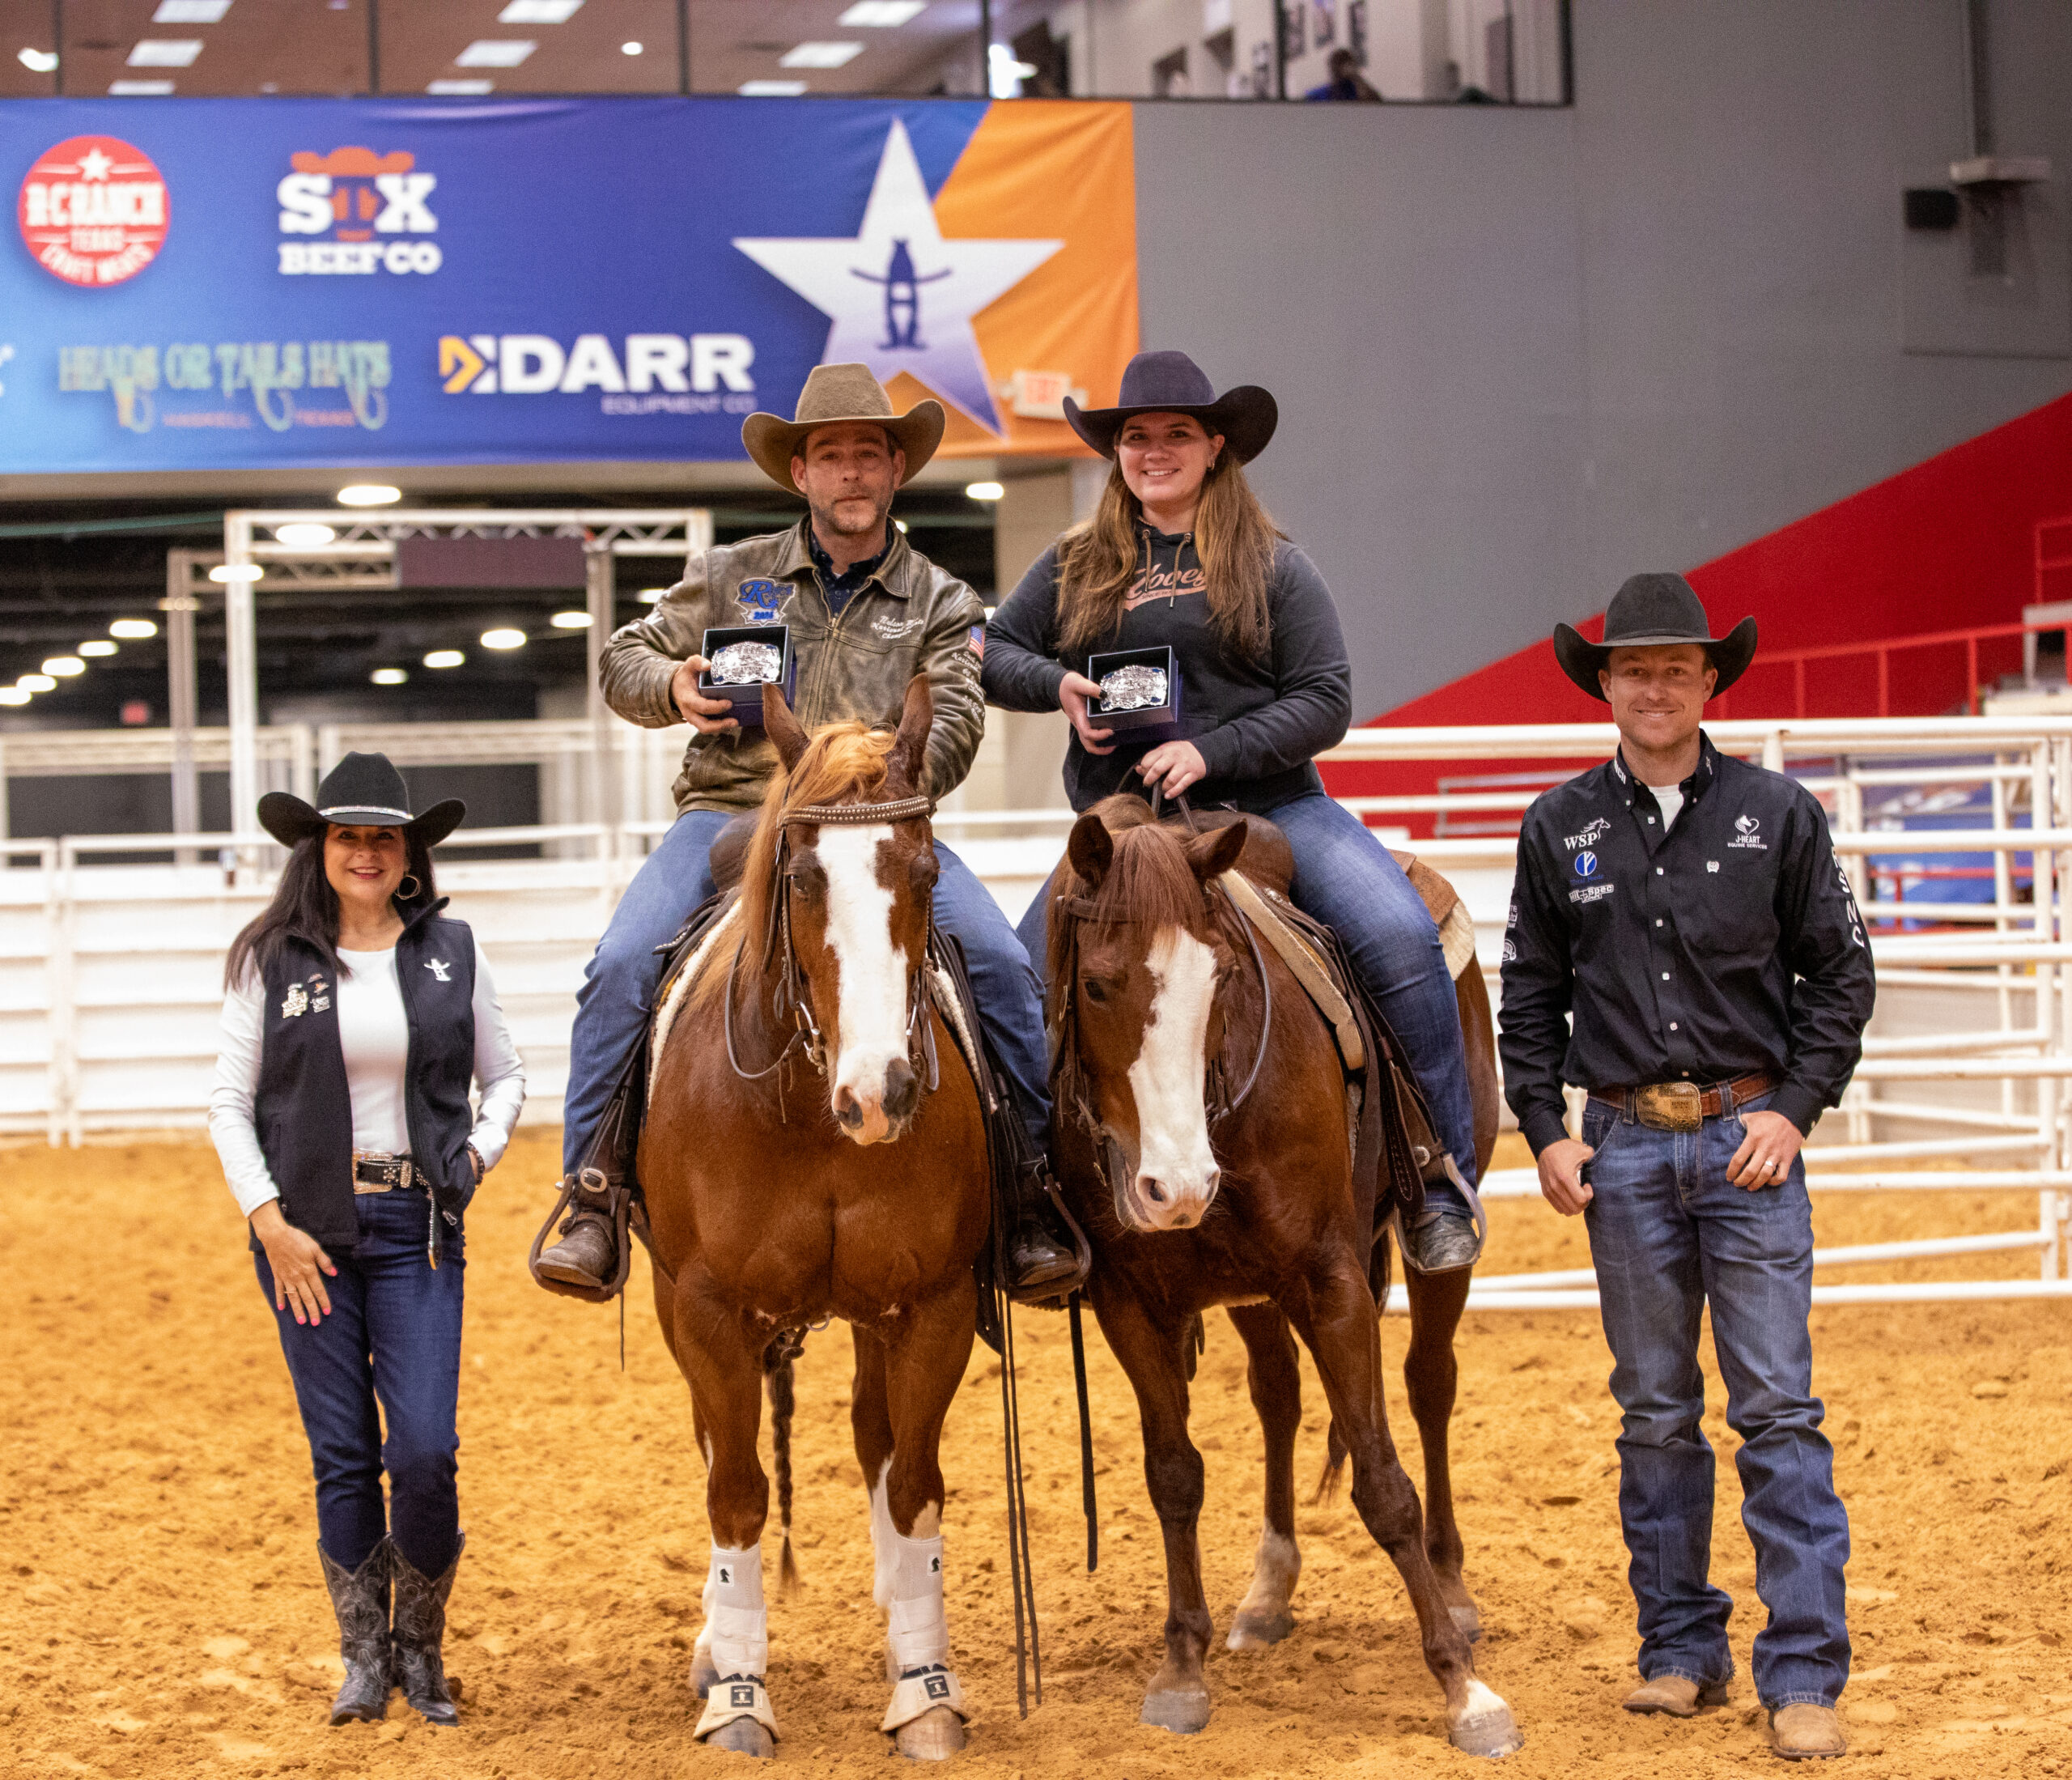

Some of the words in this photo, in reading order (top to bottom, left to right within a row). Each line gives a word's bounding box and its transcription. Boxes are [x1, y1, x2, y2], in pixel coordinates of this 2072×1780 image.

[278, 241, 384, 275] BEEF
[384, 240, 443, 275] CO
[499, 333, 755, 394] DARR
[1564, 832, 1598, 850] WSP
